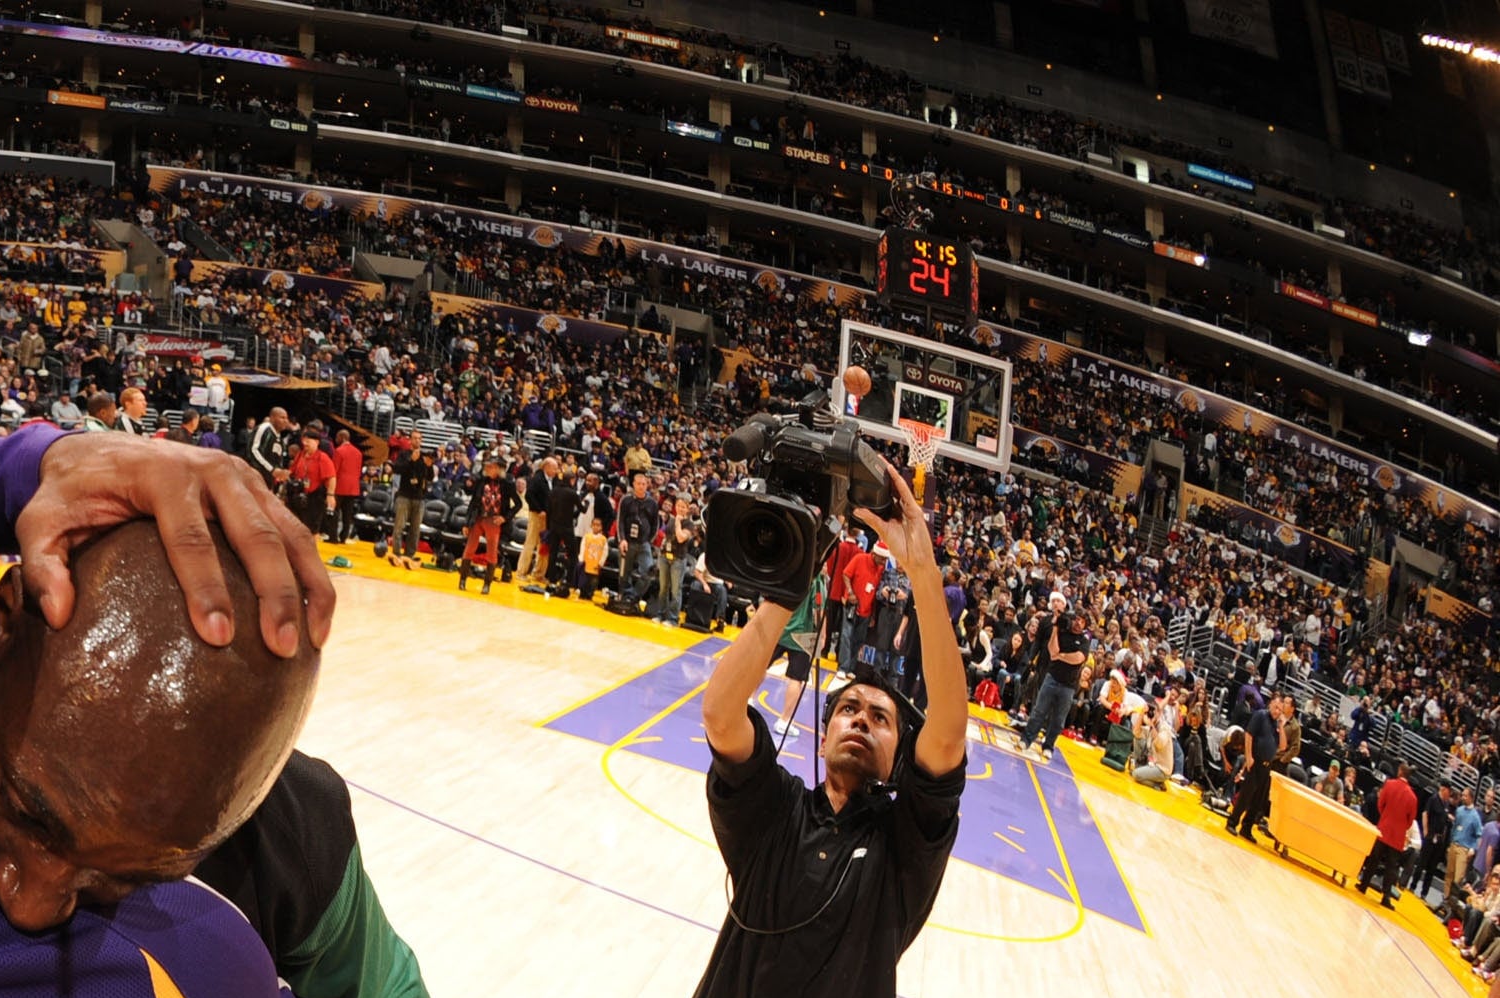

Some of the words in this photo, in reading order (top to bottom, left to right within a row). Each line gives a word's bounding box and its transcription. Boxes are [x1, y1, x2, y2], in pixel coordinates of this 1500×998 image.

[417, 79, 462, 93] WACHOVIA
[540, 98, 580, 114] TOYOTA
[784, 145, 831, 166] STAPLES
[884, 167, 894, 182] 0
[914, 238, 957, 267] 4:15
[908, 256, 951, 298] 24
[133, 333, 212, 355] Budweiser
[927, 373, 965, 392] OYOTA
[1109, 369, 1172, 399] LAKERS
[1310, 442, 1370, 476] LAKERS
